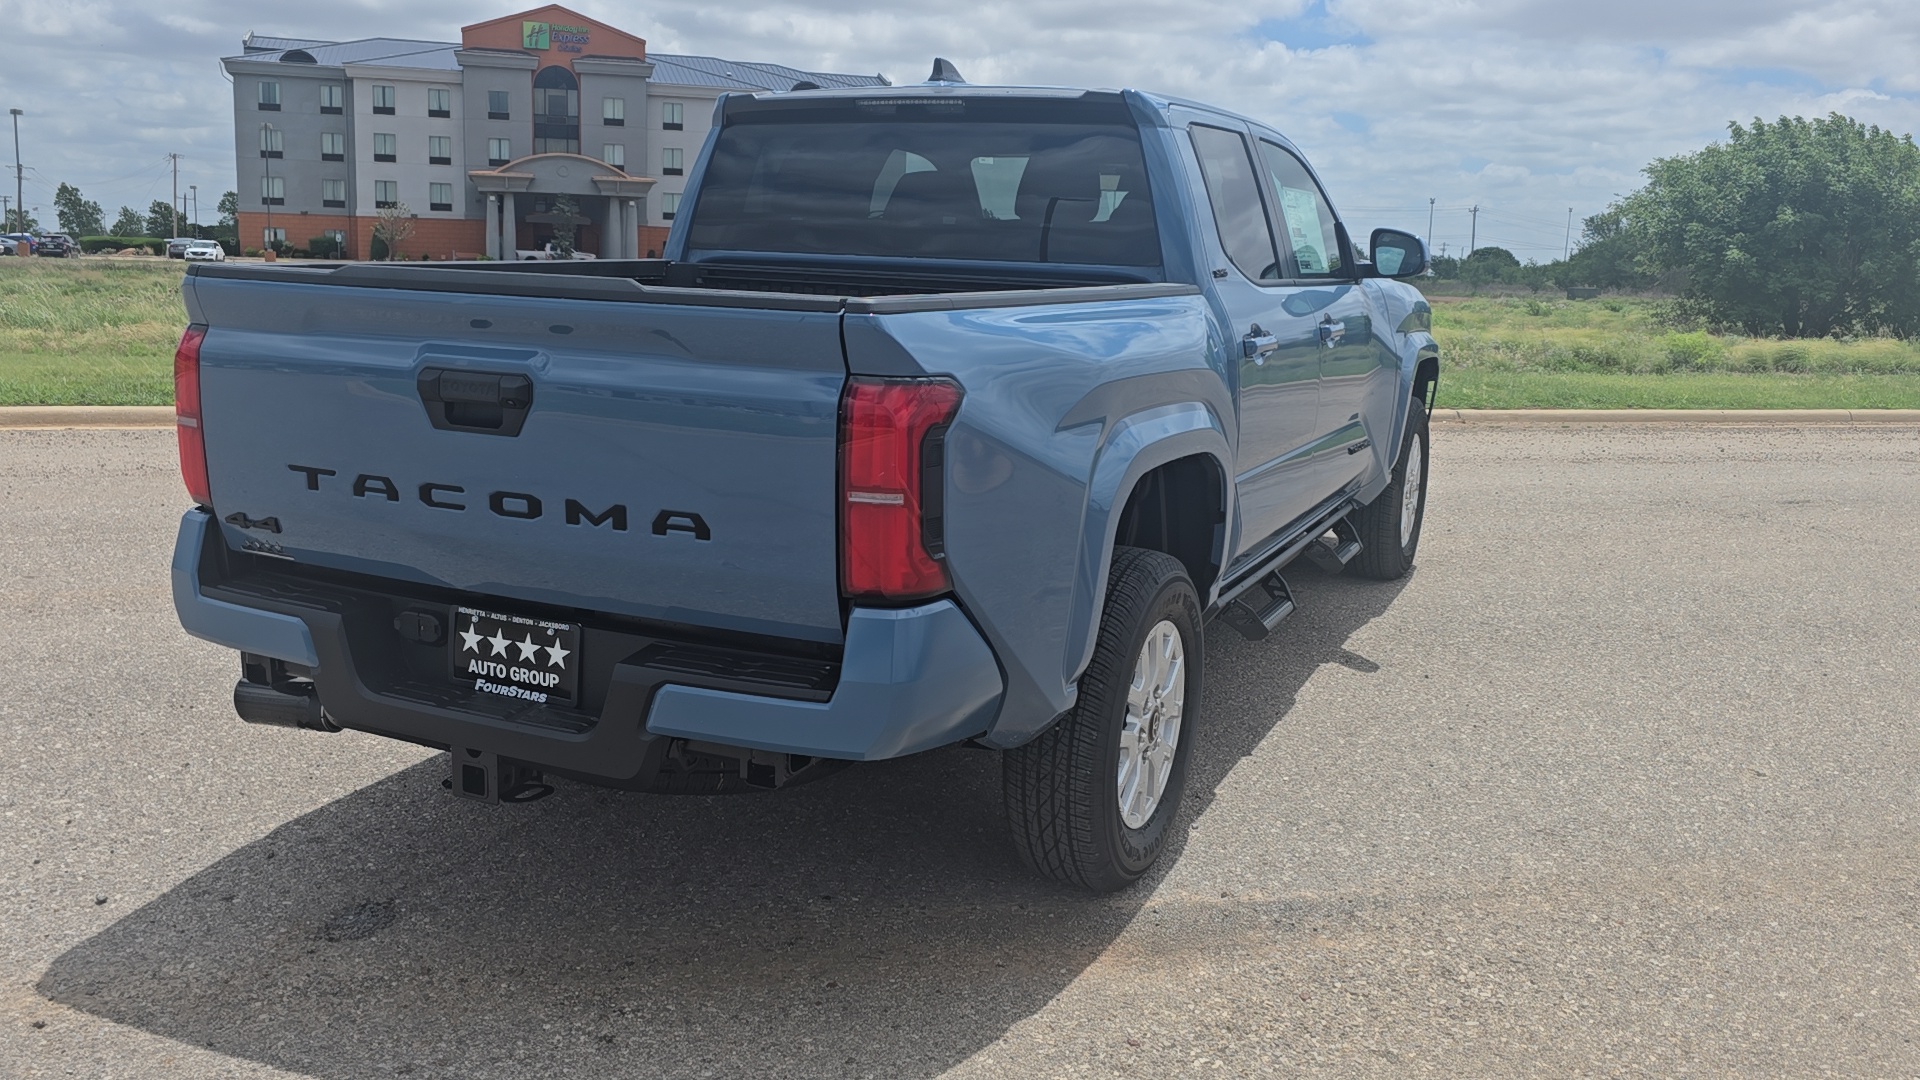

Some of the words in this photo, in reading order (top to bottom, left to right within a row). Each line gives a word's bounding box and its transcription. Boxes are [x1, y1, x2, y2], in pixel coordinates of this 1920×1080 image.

[551, 23, 578, 34] Holiday
[551, 31, 590, 44] Express
[287, 464, 711, 541] TACOMA
[458, 607, 486, 618] HENRIETTA
[490, 612, 508, 622] ALTUS
[512, 616, 534, 626] DENTON
[538, 620, 570, 631] JACKSBORO
[468, 658, 507, 679] AUTO
[510, 666, 560, 688] GROUP
